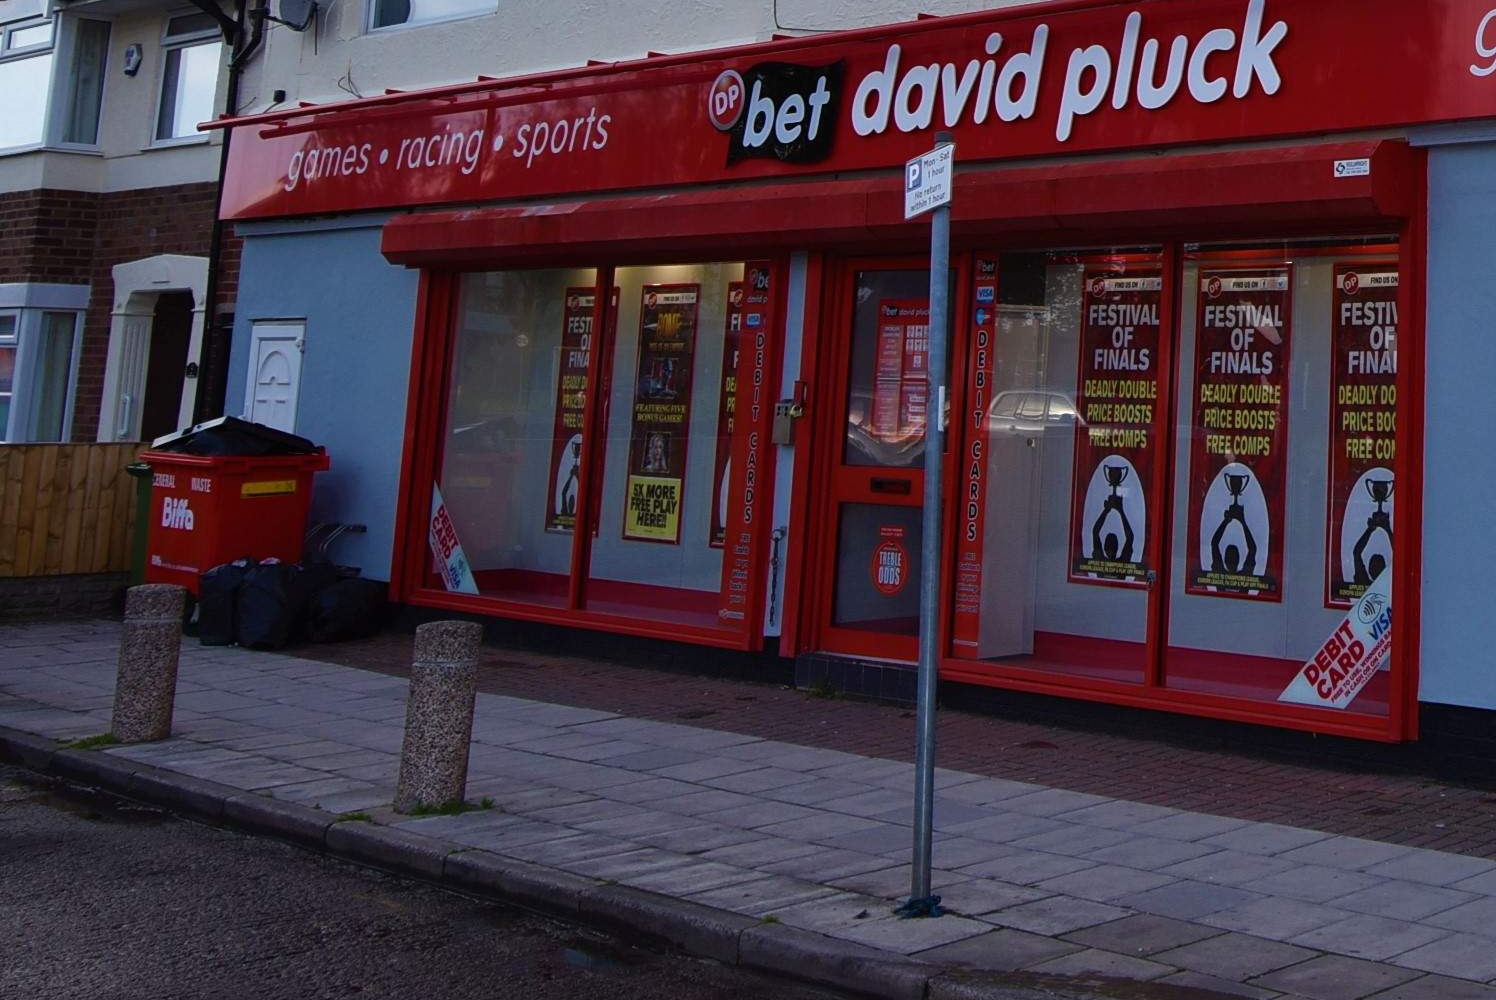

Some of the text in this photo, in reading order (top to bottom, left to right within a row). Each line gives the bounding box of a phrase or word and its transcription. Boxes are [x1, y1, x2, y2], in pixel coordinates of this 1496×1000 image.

[742, 76, 831, 149] bet
[851, 23, 1050, 136] david
[284, 107, 612, 192] games racing sports
[923, 158, 936, 169] Mon
[939, 151, 950, 162] Sat
[908, 163, 920, 189] P
[932, 166, 945, 178] hour
[910, 199, 928, 212] within
[932, 191, 946, 203] hour
[914, 183, 942, 200] No return
[1089, 304, 1160, 327] FESTIVAL
[1204, 304, 1283, 328] FESTIVAL
[1112, 326, 1134, 348] OF
[1230, 328, 1255, 351] OF
[1369, 325, 1395, 350] OF
[1094, 348, 1150, 371] FINALS
[1210, 351, 1273, 375] FINALS
[752, 332, 765, 422] DEBIT
[975, 330, 988, 429] DEBIT
[1085, 380, 1157, 399] DEADLY DOUBLE
[1201, 383, 1280, 404] DEADLY DOUBLE
[1338, 384, 1378, 405] DEADLY
[1087, 403, 1152, 424] PRICE BOOSTS
[1204, 408, 1276, 430] PRICE BOOSTS
[1342, 411, 1374, 432] PRICE
[1089, 428, 1148, 449] FREE COMPS
[1206, 434, 1271, 456] FREE COMPS
[1345, 438, 1373, 460] FREE
[191, 477, 211, 493] WASTE
[744, 432, 758, 524] CARDS
[633, 483, 676, 500] 5X MORE
[967, 440, 981, 541] CARDS
[161, 496, 194, 531] Biffa
[630, 497, 678, 514] FREE PLAY
[432, 516, 451, 559] CARD
[438, 504, 459, 550] DEBIT
[879, 551, 902, 567] TREBLE
[878, 567, 900, 585] ODDS
[1303, 618, 1354, 687] DEBIT
[1317, 640, 1365, 699] CARD
